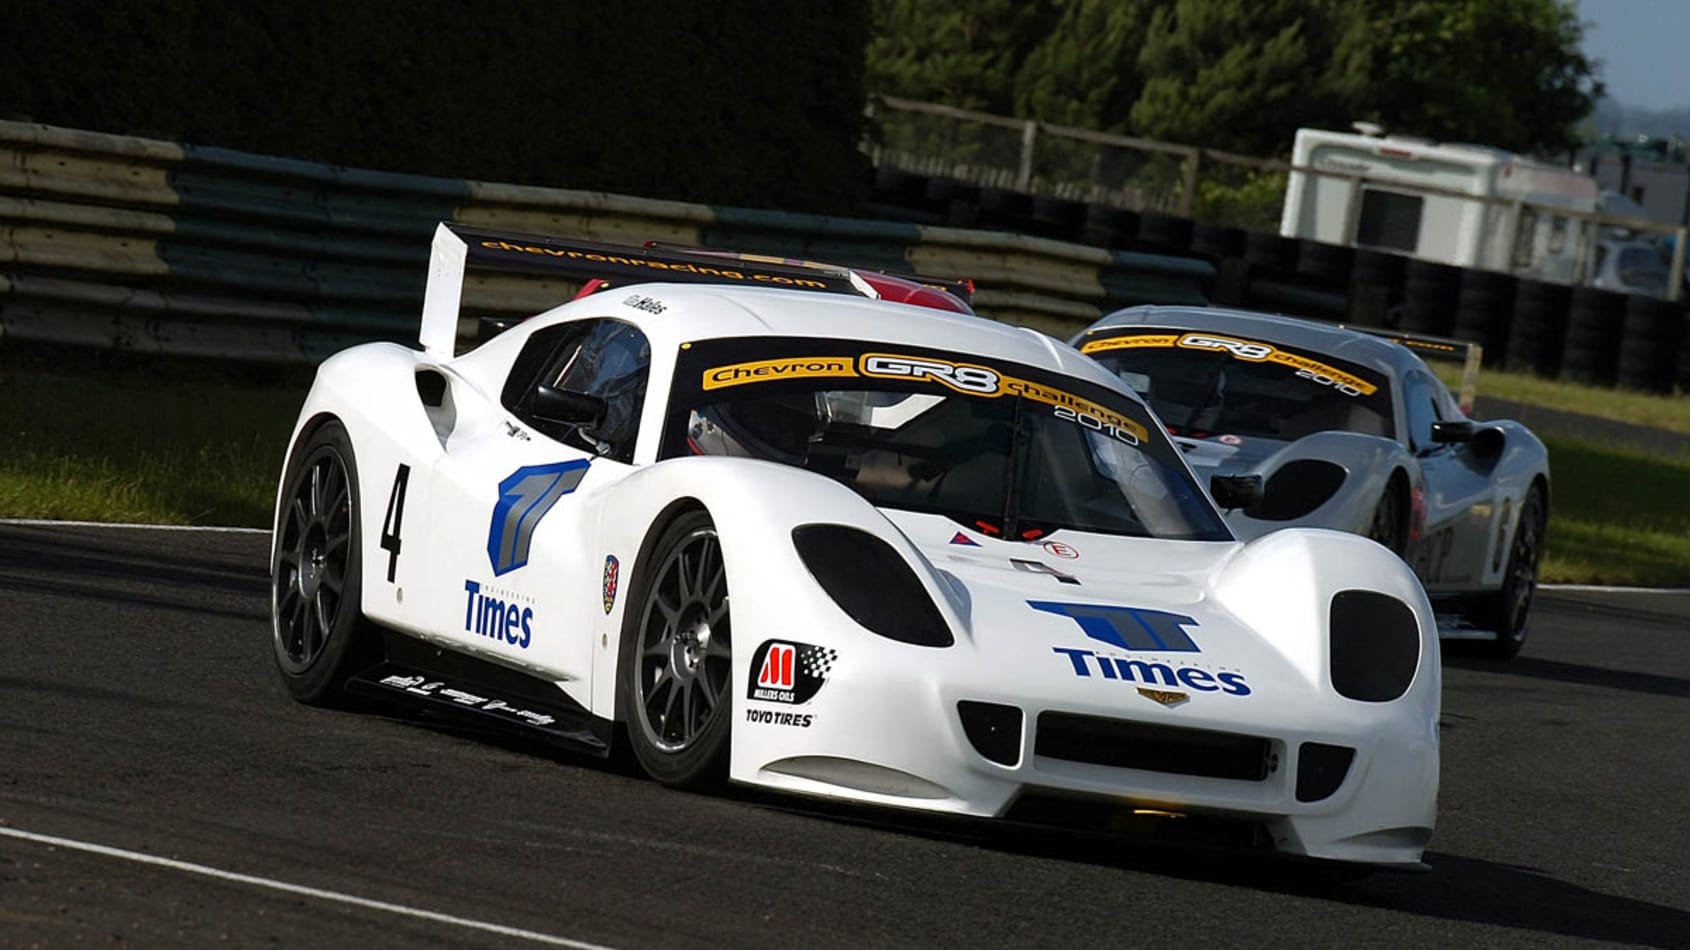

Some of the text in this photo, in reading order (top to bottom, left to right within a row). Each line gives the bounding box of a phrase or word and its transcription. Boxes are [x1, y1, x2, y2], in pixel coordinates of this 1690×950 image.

[481, 240, 827, 289] chevronracing.com
[1182, 336, 1273, 359] GR8
[712, 356, 1139, 432] Chevron GR8 challenge
[1294, 367, 1361, 397] 2010
[1053, 404, 1139, 447] 2010
[380, 463, 411, 584] 4
[464, 579, 534, 650] Times
[1052, 647, 1252, 697] Times
[746, 709, 814, 728] TOYO TIRES
